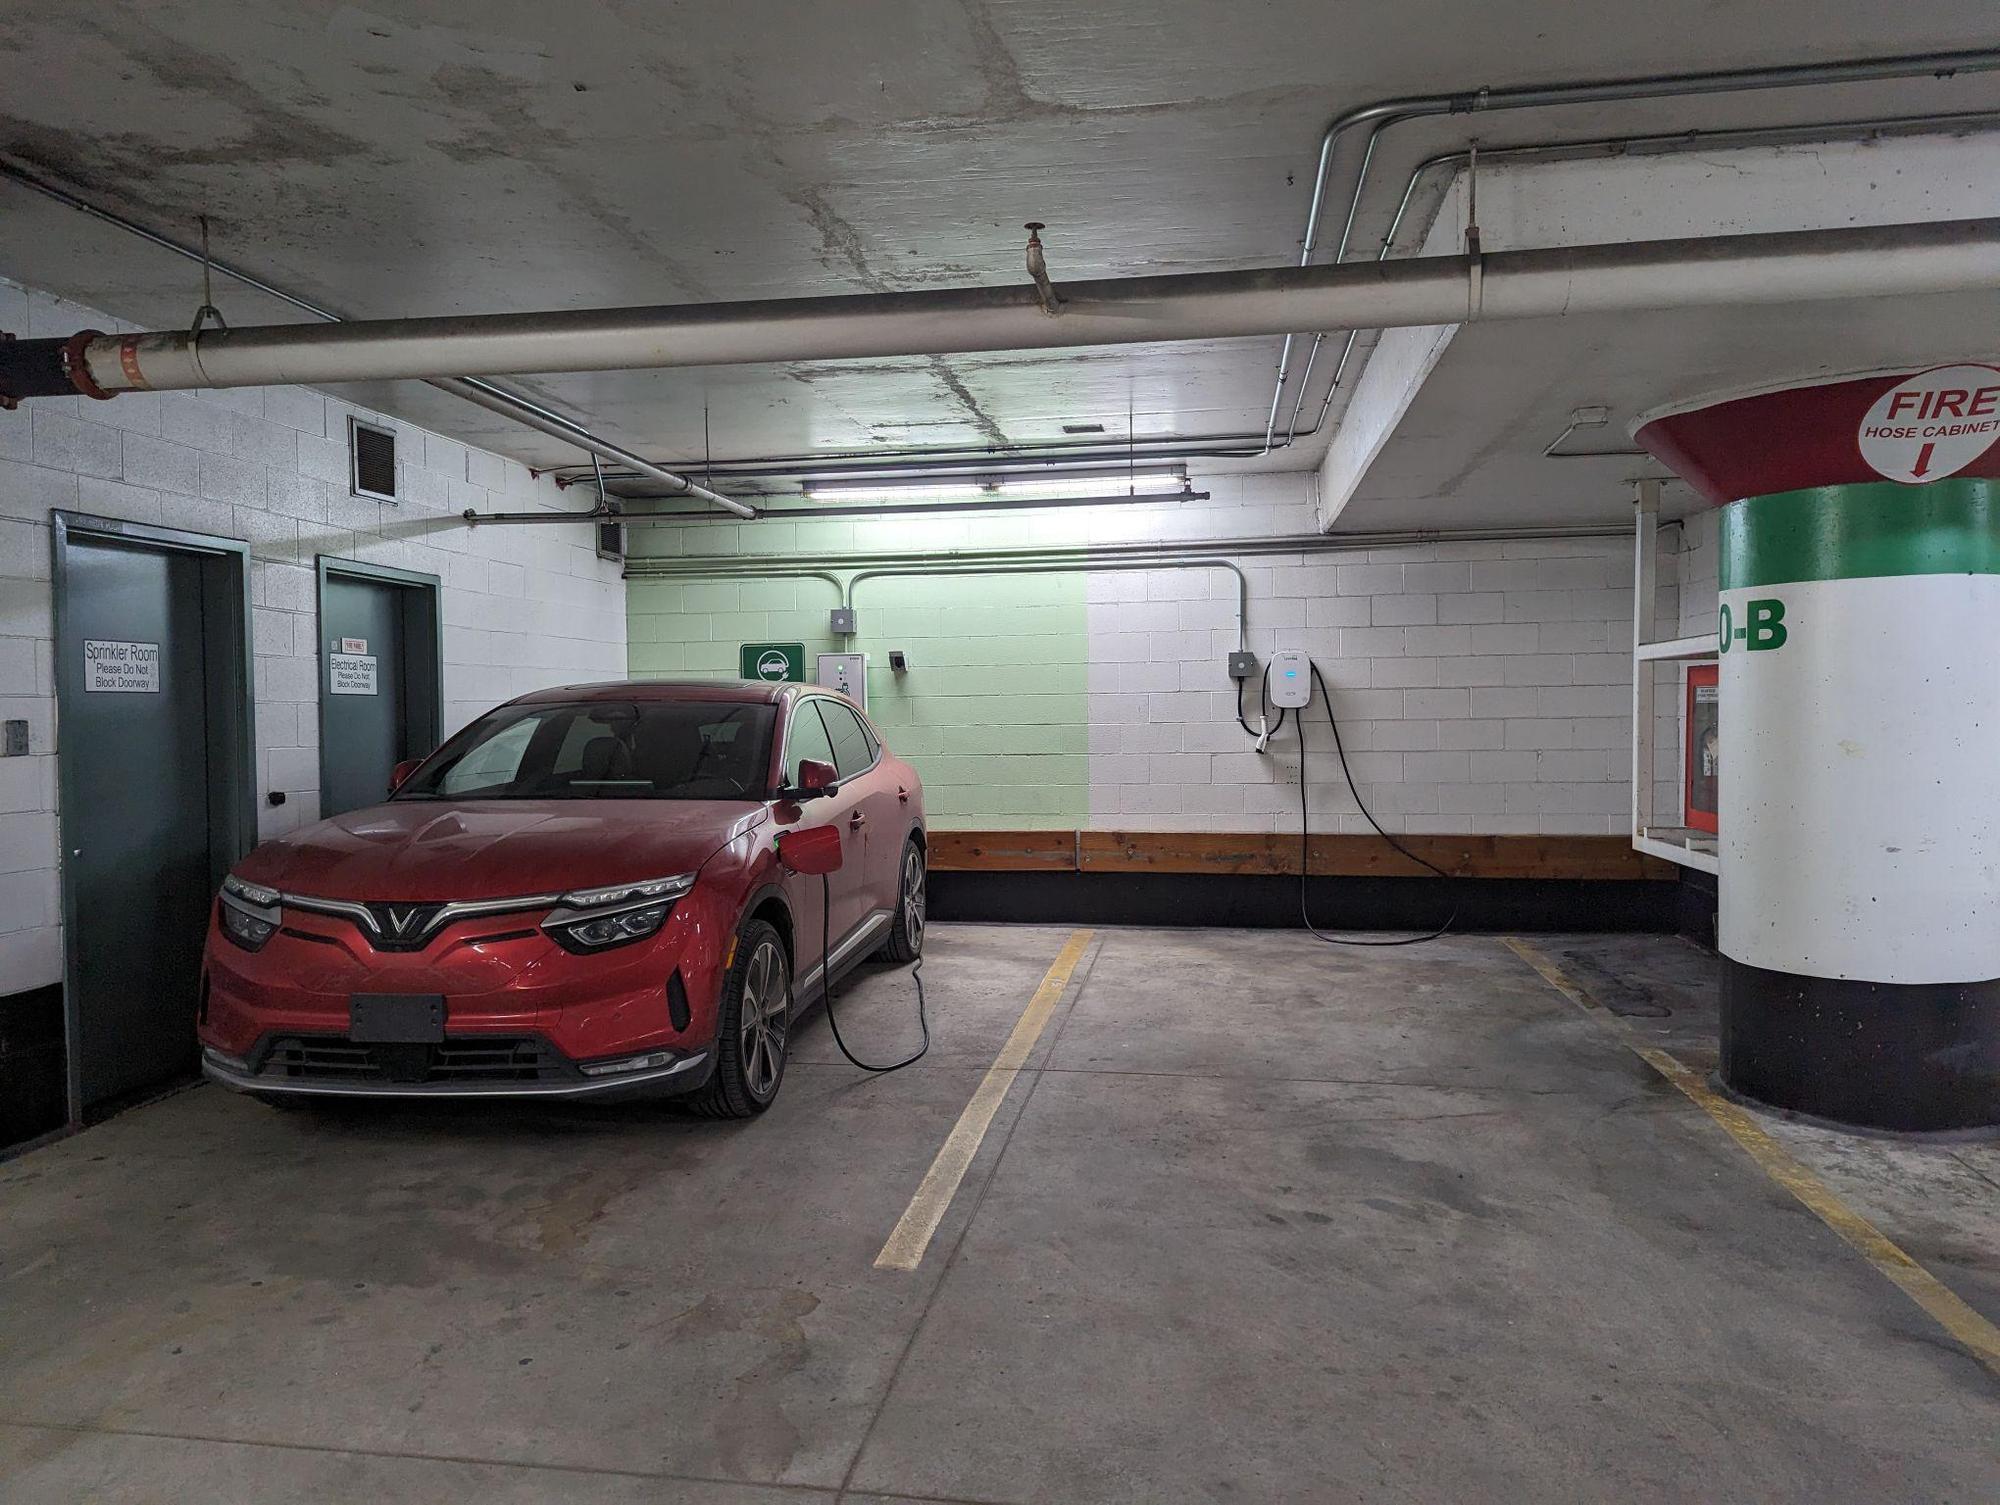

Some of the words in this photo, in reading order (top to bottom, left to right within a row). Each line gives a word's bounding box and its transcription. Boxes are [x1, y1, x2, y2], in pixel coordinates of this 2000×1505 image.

[1886, 386, 2000, 420] FIRE
[1865, 426, 1917, 438] HOSE
[1923, 420, 2000, 438] CABINET
[86, 641, 128, 664] Sprinkler
[130, 644, 158, 662] Room
[96, 663, 121, 675] Please
[123, 663, 134, 675] Do
[136, 664, 149, 676] Not
[95, 676, 117, 688] Block
[118, 677, 149, 690] Doorway
